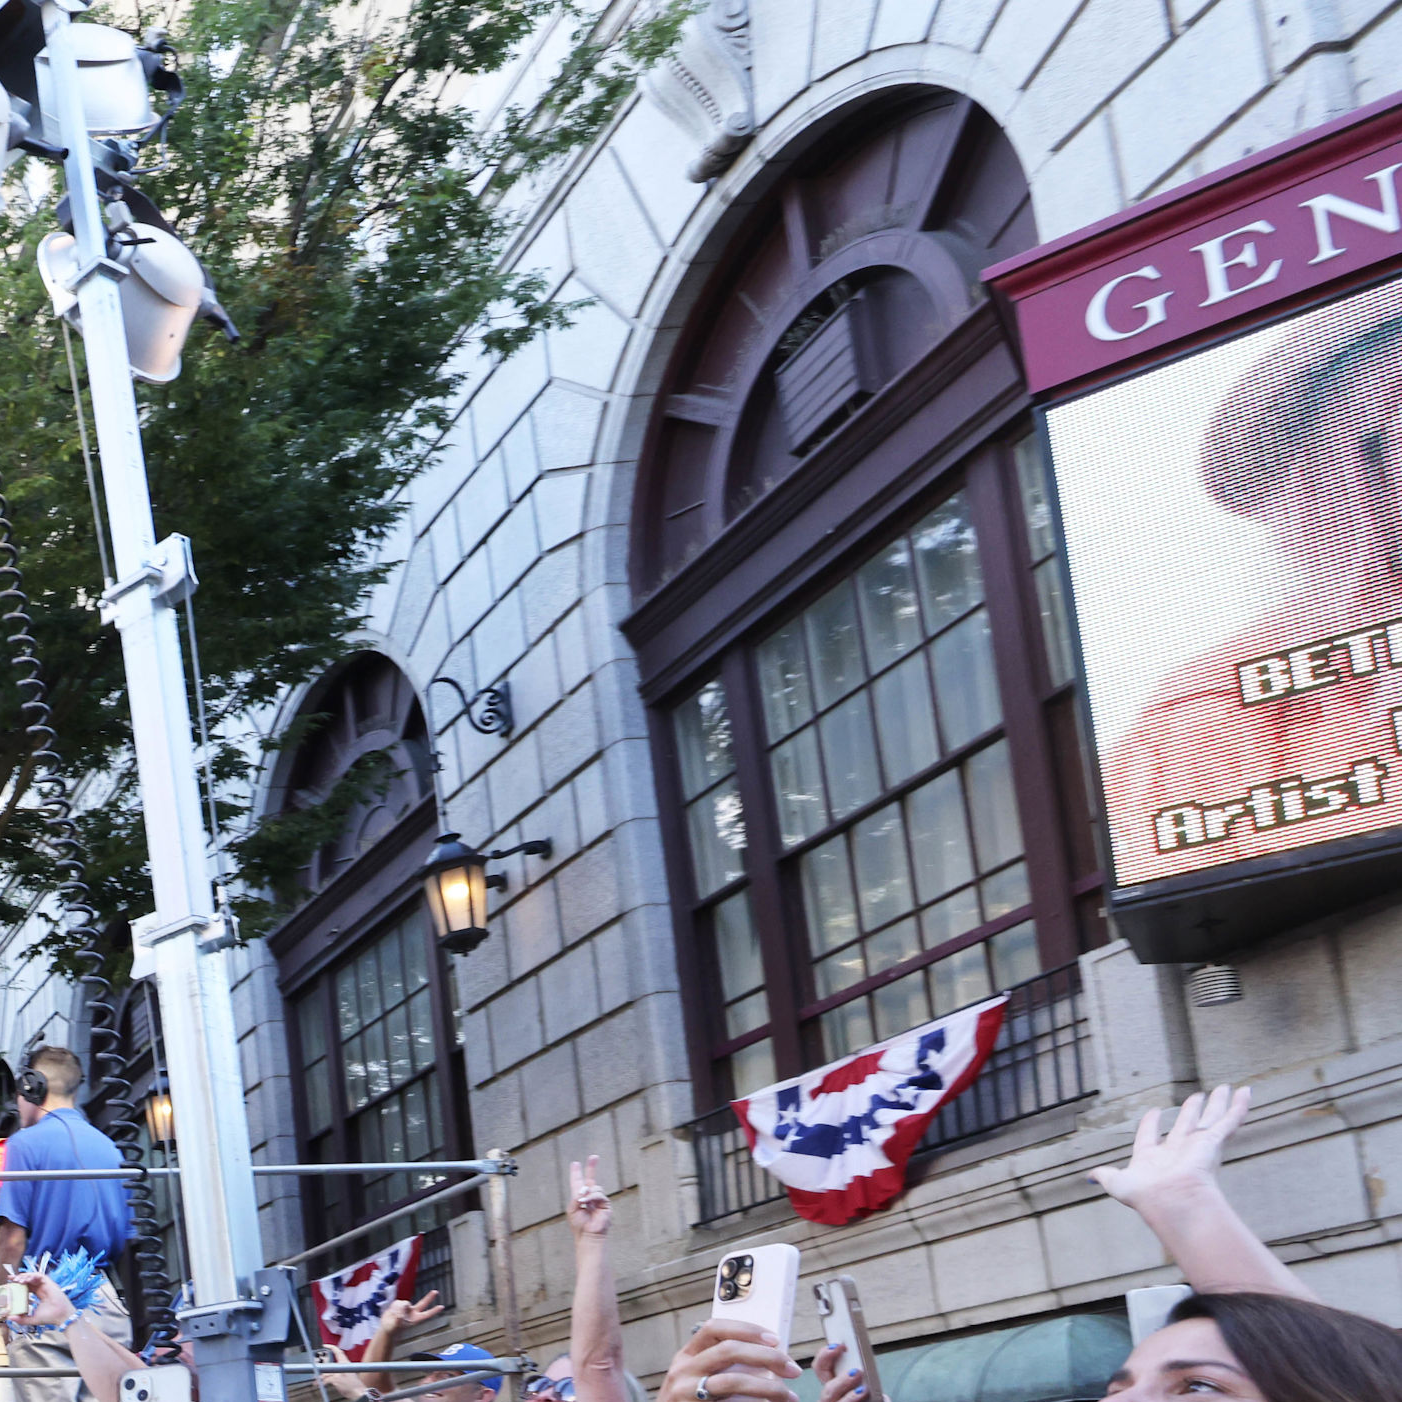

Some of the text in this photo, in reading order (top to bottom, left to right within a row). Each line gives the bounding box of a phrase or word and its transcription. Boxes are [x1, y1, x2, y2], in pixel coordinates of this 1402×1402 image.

[1085, 163, 1402, 342] GEN
[1239, 620, 1402, 704] BET
[1154, 762, 1386, 851] Artist
